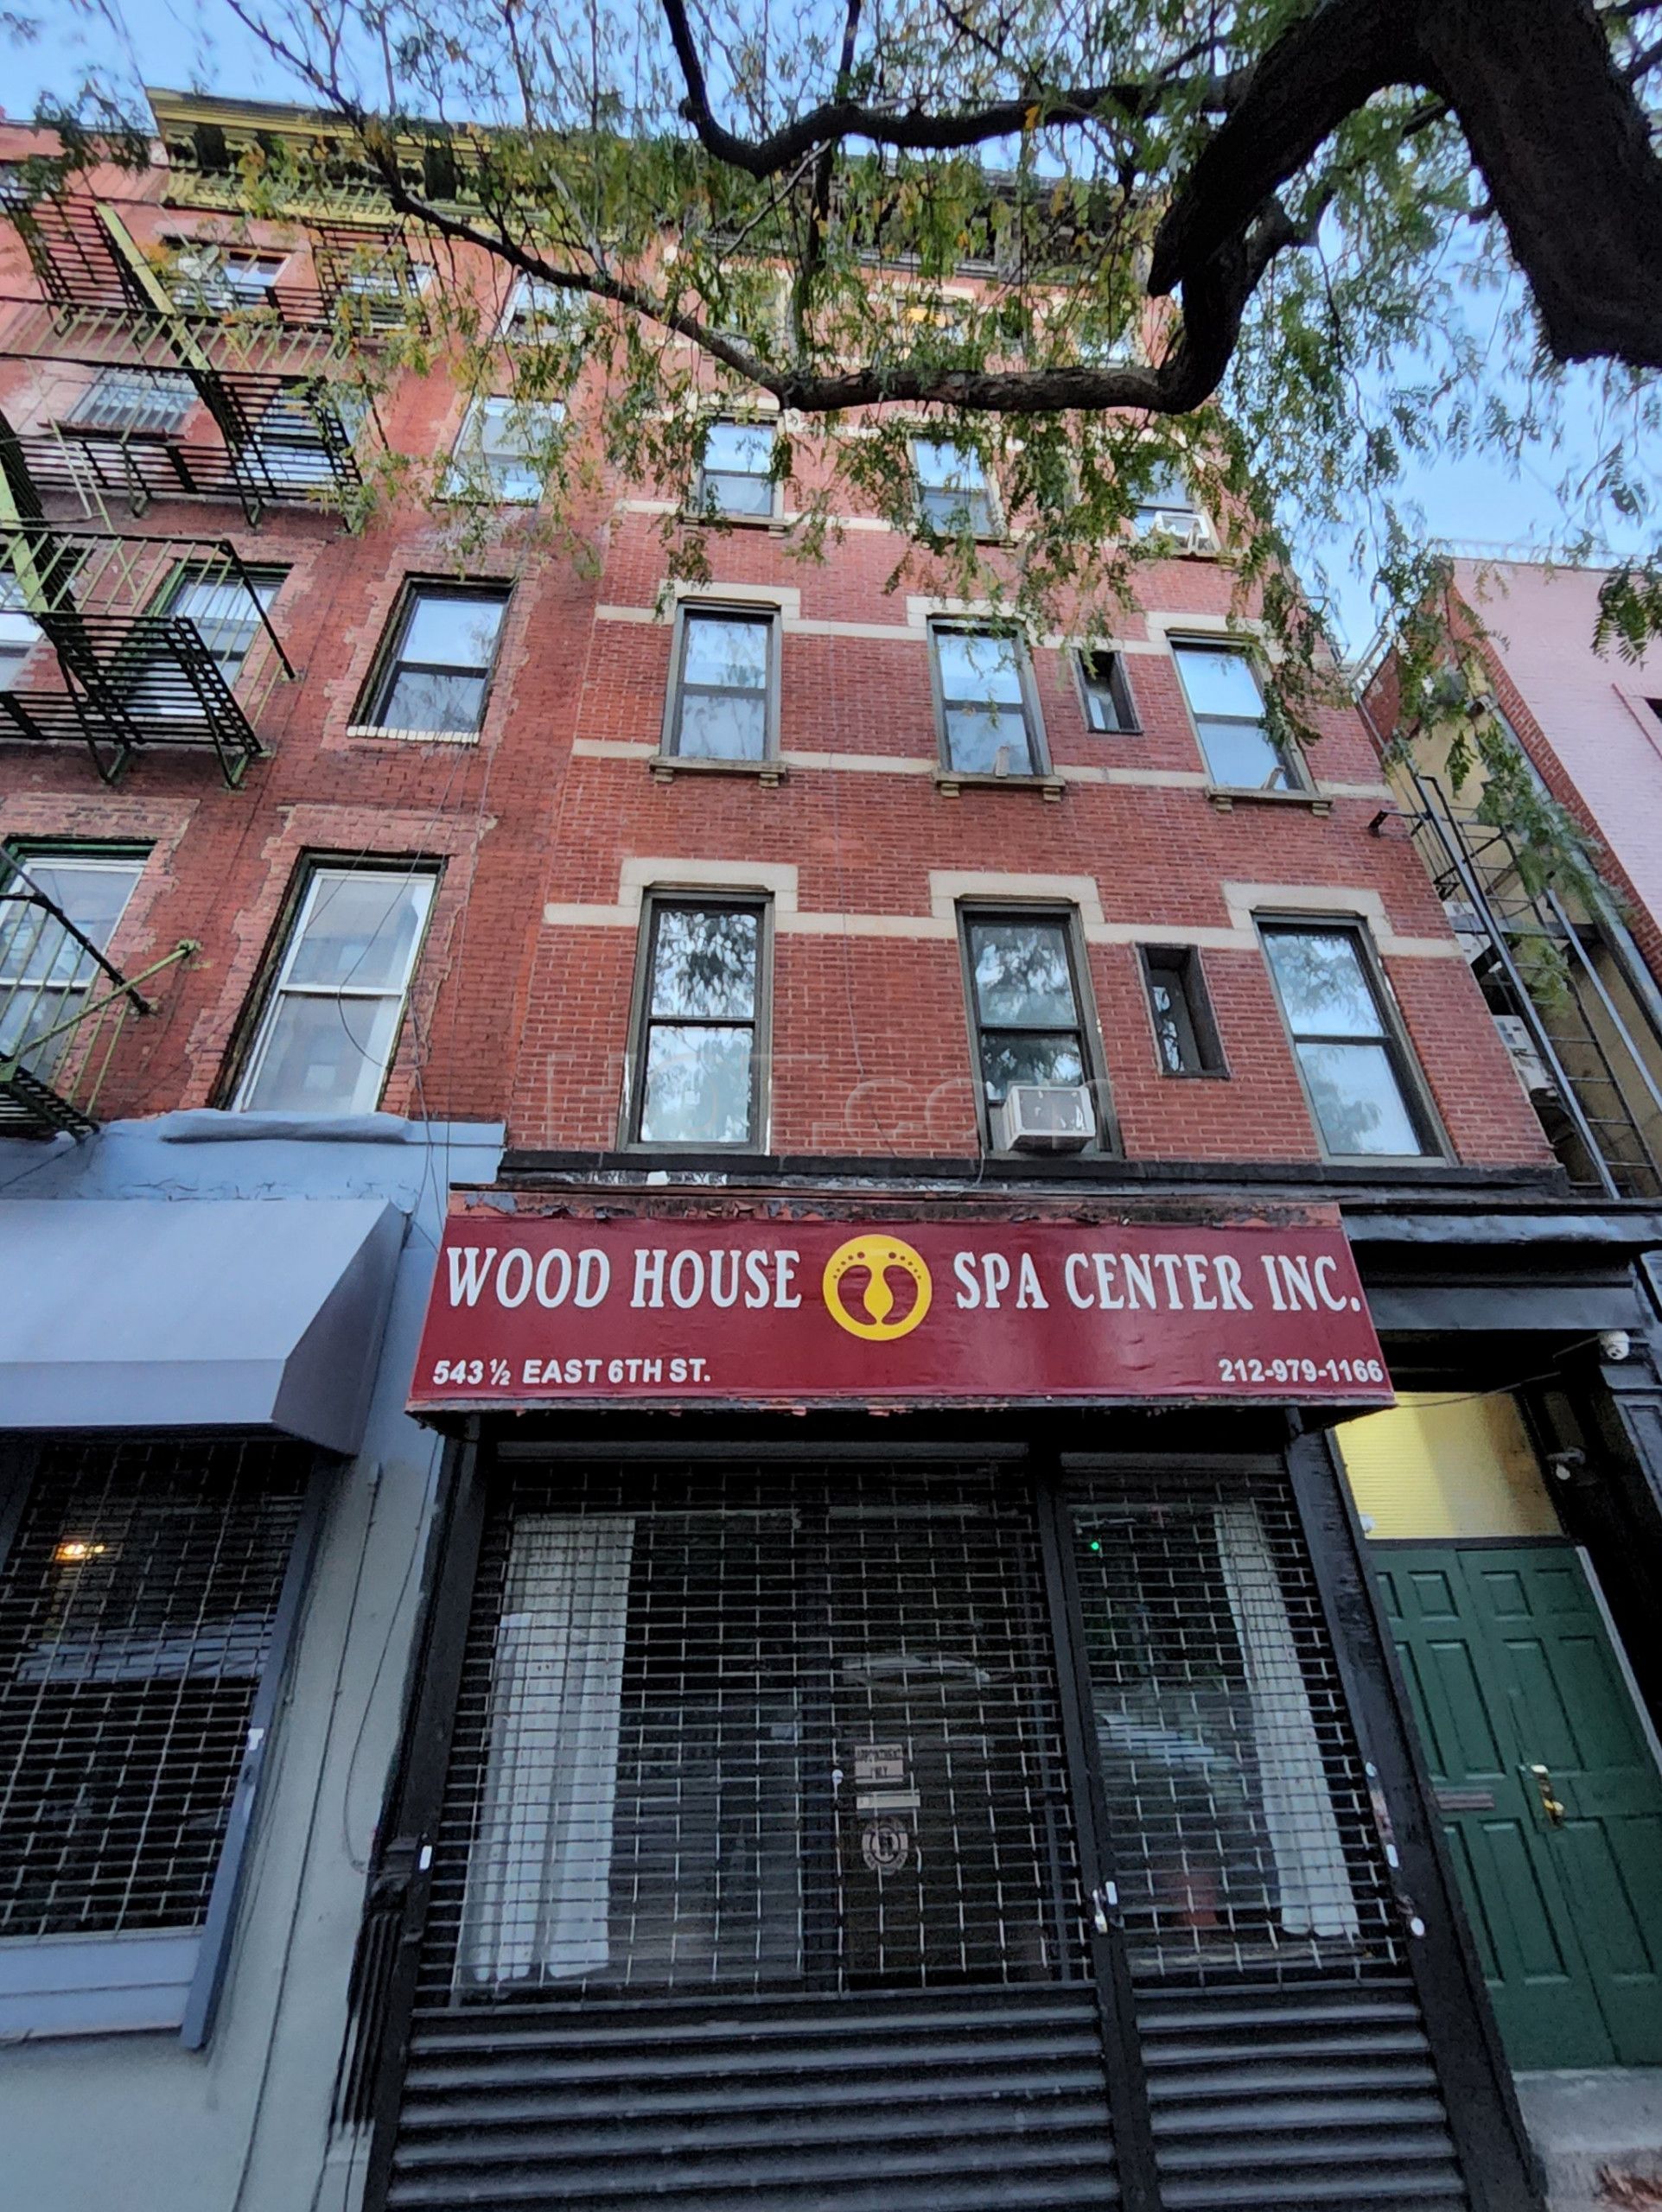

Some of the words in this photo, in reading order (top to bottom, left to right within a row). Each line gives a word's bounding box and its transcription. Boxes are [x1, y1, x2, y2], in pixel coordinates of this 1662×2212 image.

[446, 1247, 610, 1308] WOOD
[629, 1249, 802, 1309] HOUSE
[953, 1251, 1049, 1310] SPA
[1064, 1252, 1254, 1311] CENTER
[1260, 1255, 1361, 1312] INC.
[522, 1358, 603, 1384] EAST
[608, 1358, 663, 1383] 6TH
[669, 1357, 711, 1382] ST.
[1218, 1358, 1384, 1382] 212-979-1166
